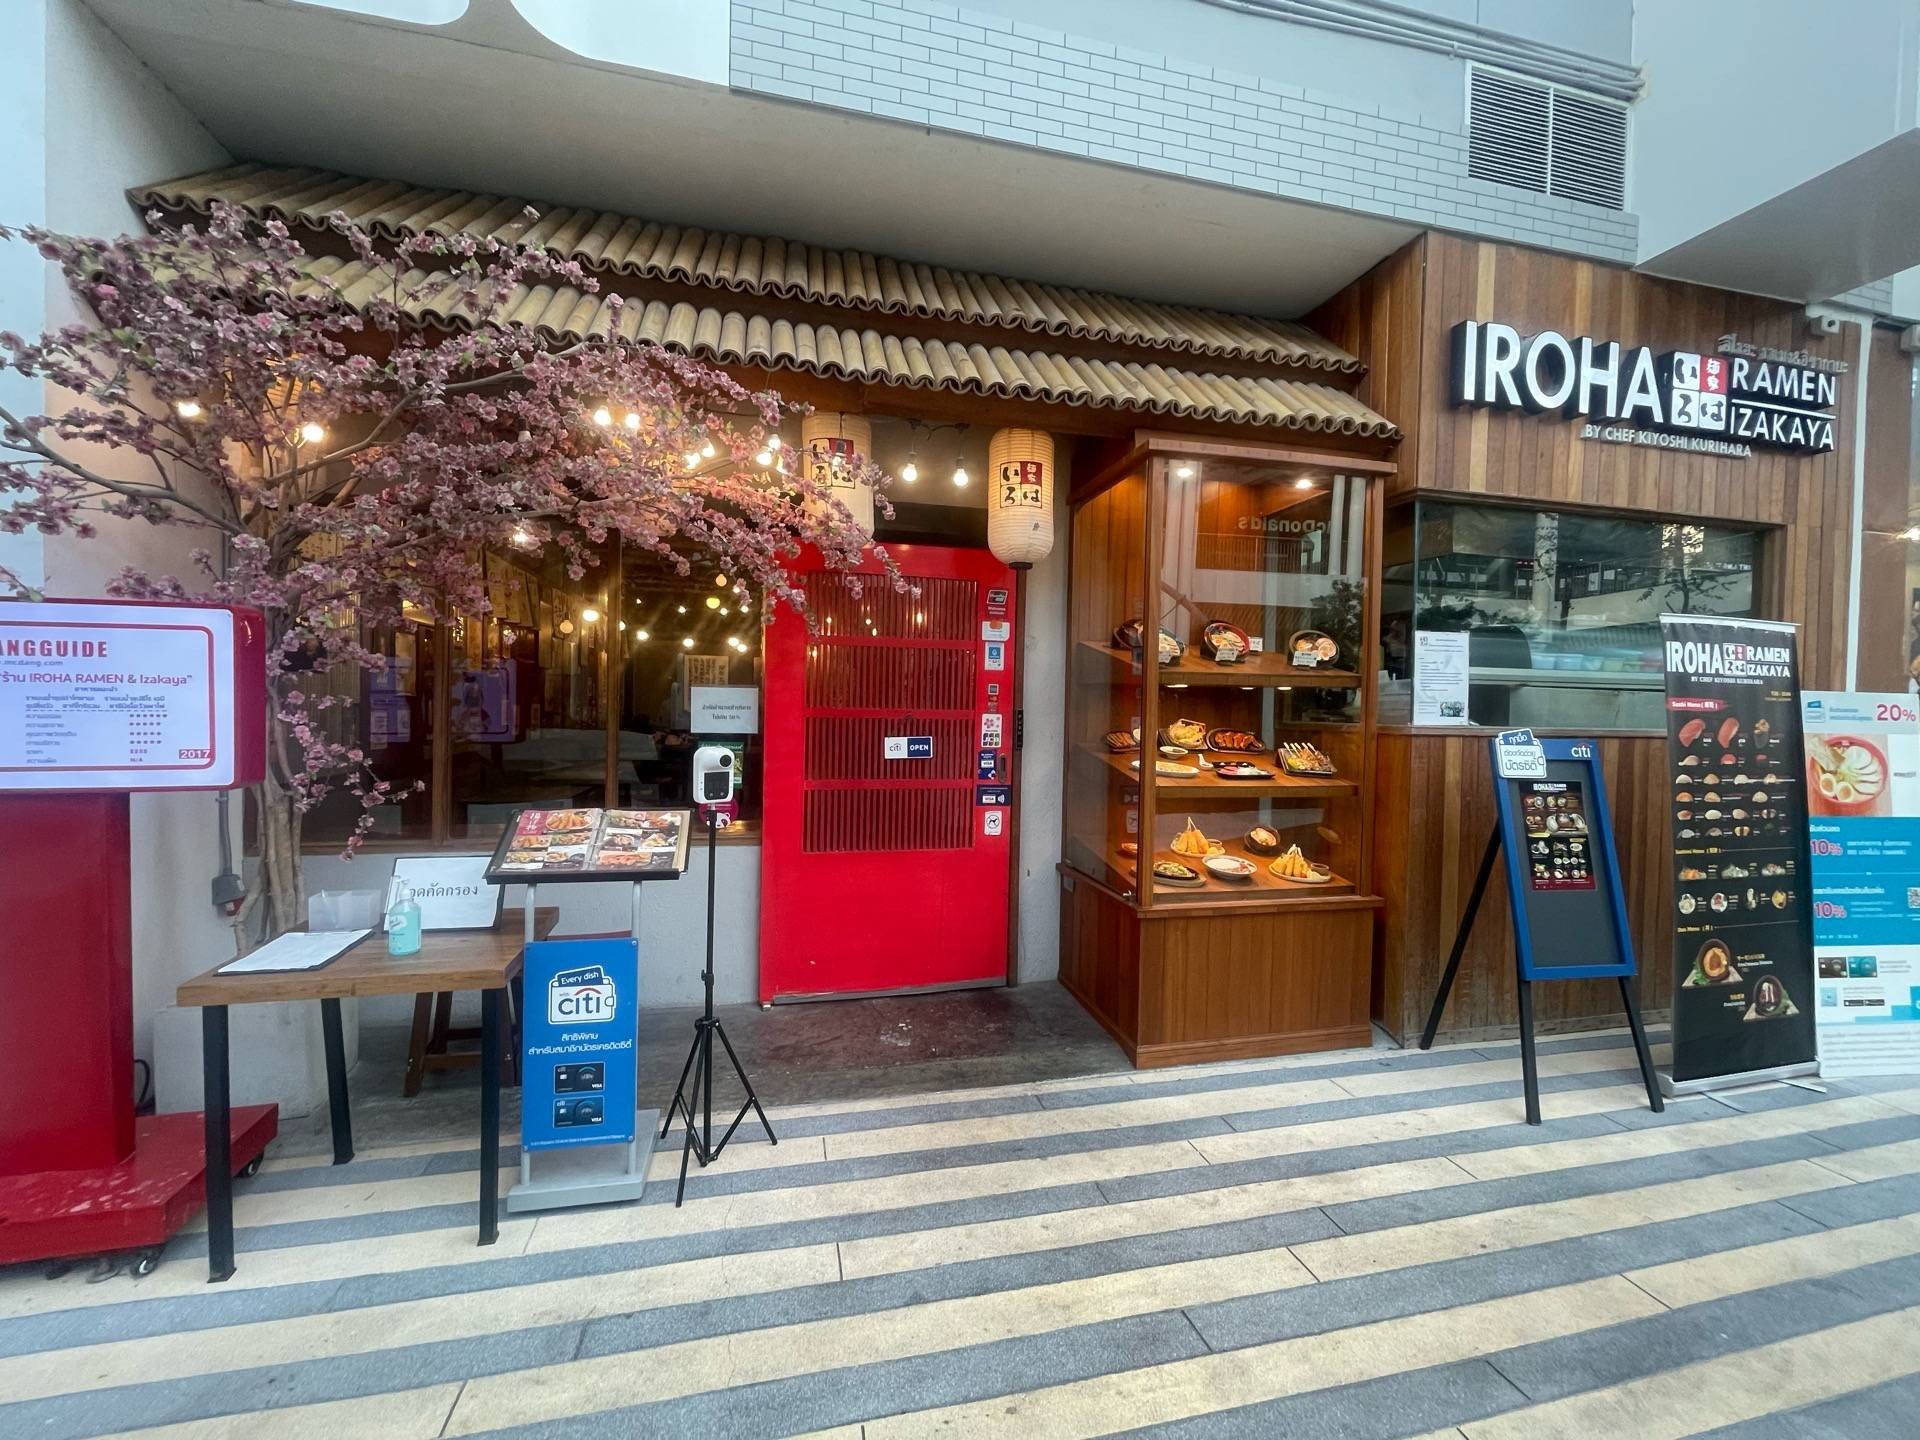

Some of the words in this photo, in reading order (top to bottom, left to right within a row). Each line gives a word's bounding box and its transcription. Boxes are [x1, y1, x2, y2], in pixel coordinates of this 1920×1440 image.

[1463, 320, 1664, 424] IROHA
[1732, 357, 1836, 406] RAMEN
[1730, 406, 1835, 450] IZAKAYA
[1584, 423, 1601, 438] BY
[1605, 427, 1636, 443] CHEF
[1638, 430, 1688, 449] KIYOSHI
[1690, 437, 1752, 457] KURIHARA
[1665, 640, 1725, 675] IROHA
[1746, 646, 1790, 663] RAMEN
[29, 673, 72, 684] IROHA
[75, 674, 124, 684] RAMEN
[127, 674, 137, 684] &
[1746, 663, 1791, 678] IZAKAYA
[1876, 703, 1917, 722] 20%
[180, 750, 211, 759] 2017
[889, 744, 902, 752] citi
[1571, 744, 1591, 758] citi
[1811, 839, 1843, 855] 10%
[1814, 902, 1847, 918] 10%
[561, 974, 582, 985] Every
[583, 971, 599, 981] dish
[557, 993, 601, 1016] citi
